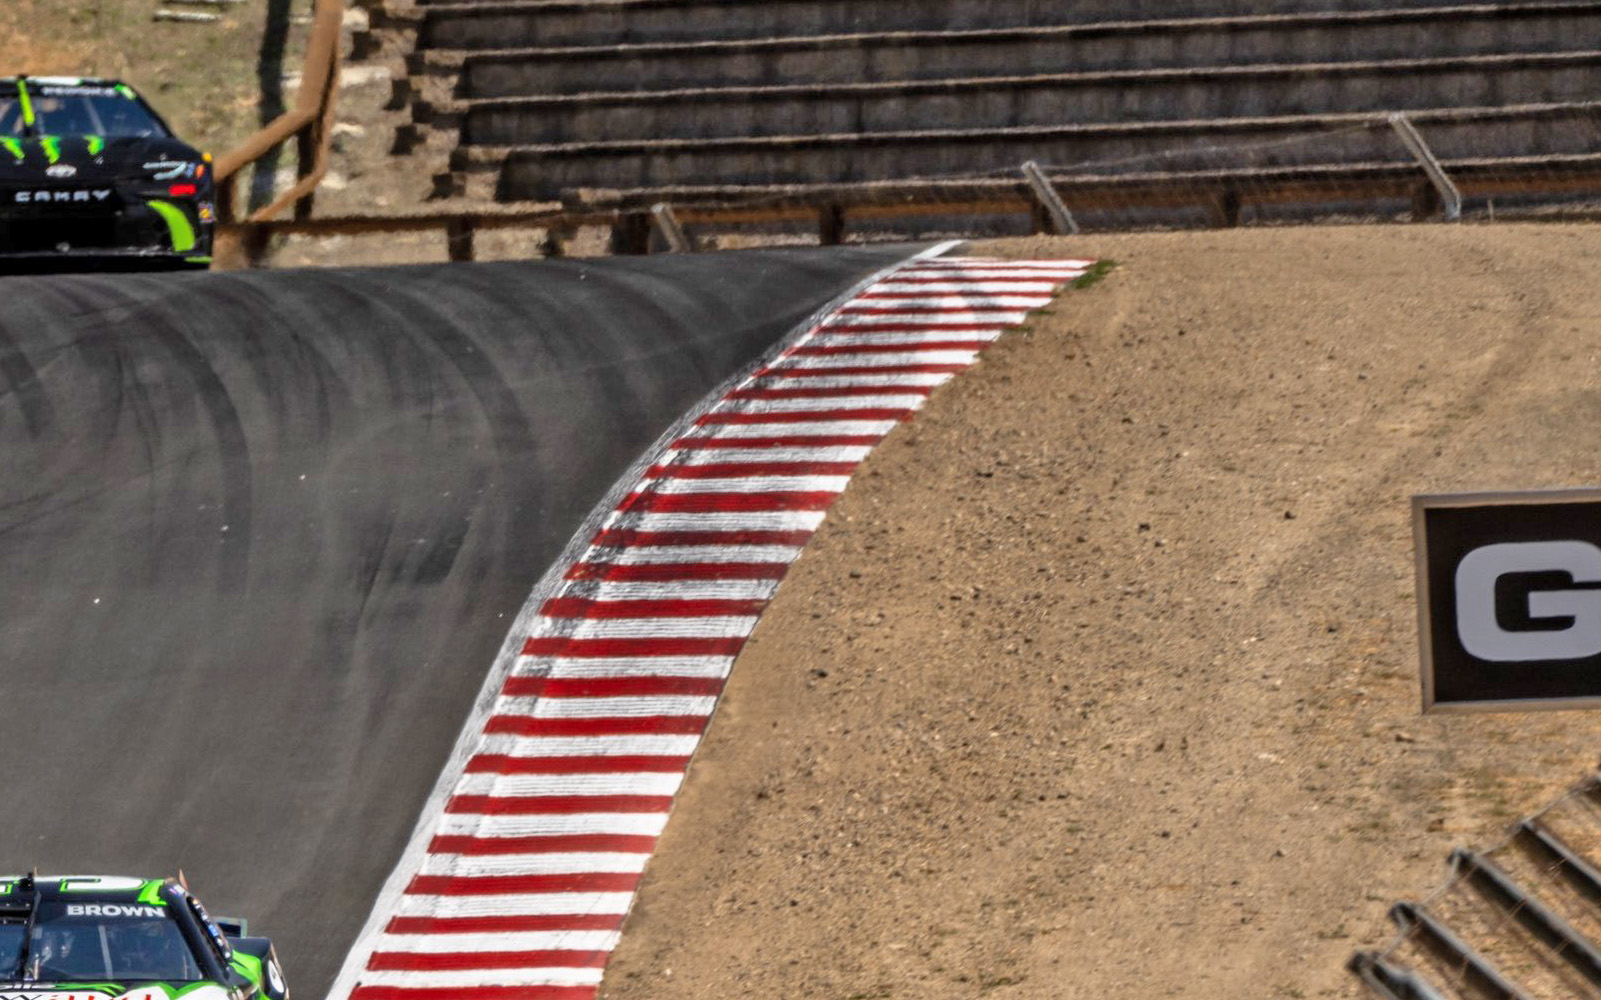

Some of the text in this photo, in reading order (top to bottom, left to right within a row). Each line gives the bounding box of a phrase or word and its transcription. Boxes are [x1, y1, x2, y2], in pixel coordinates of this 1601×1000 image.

[15, 190, 111, 202] CAMRY
[1455, 540, 1601, 662] G
[67, 904, 165, 918] BROWN
